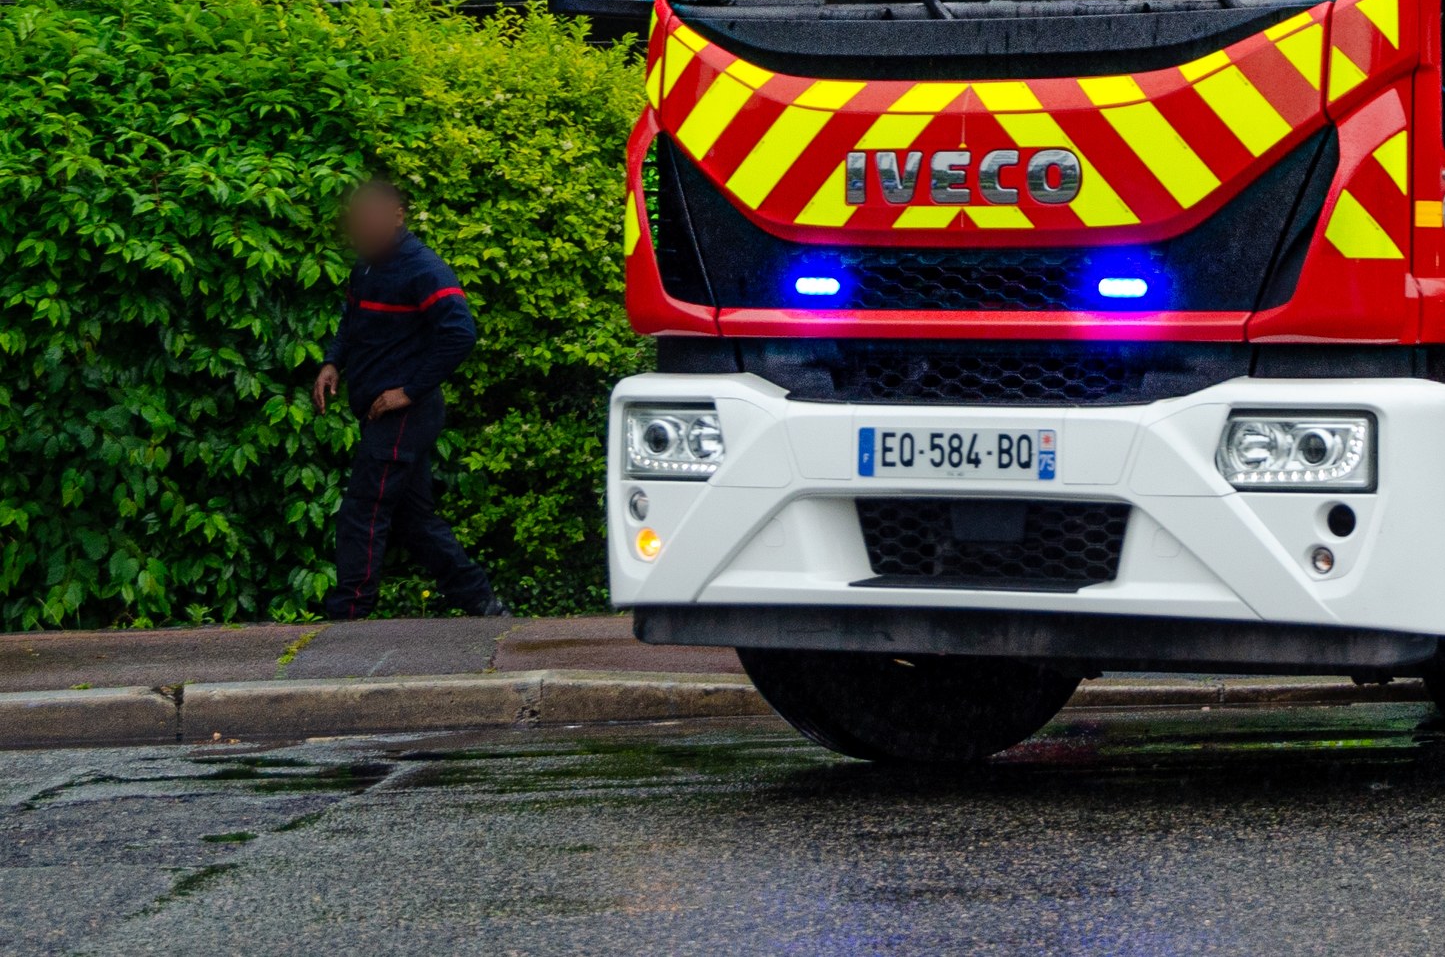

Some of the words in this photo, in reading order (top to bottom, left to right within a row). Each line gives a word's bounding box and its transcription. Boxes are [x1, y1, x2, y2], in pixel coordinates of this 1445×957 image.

[846, 149, 1083, 206] IVECO
[881, 432, 1033, 469] EQ-584-BQ
[1039, 454, 1055, 471] 75
